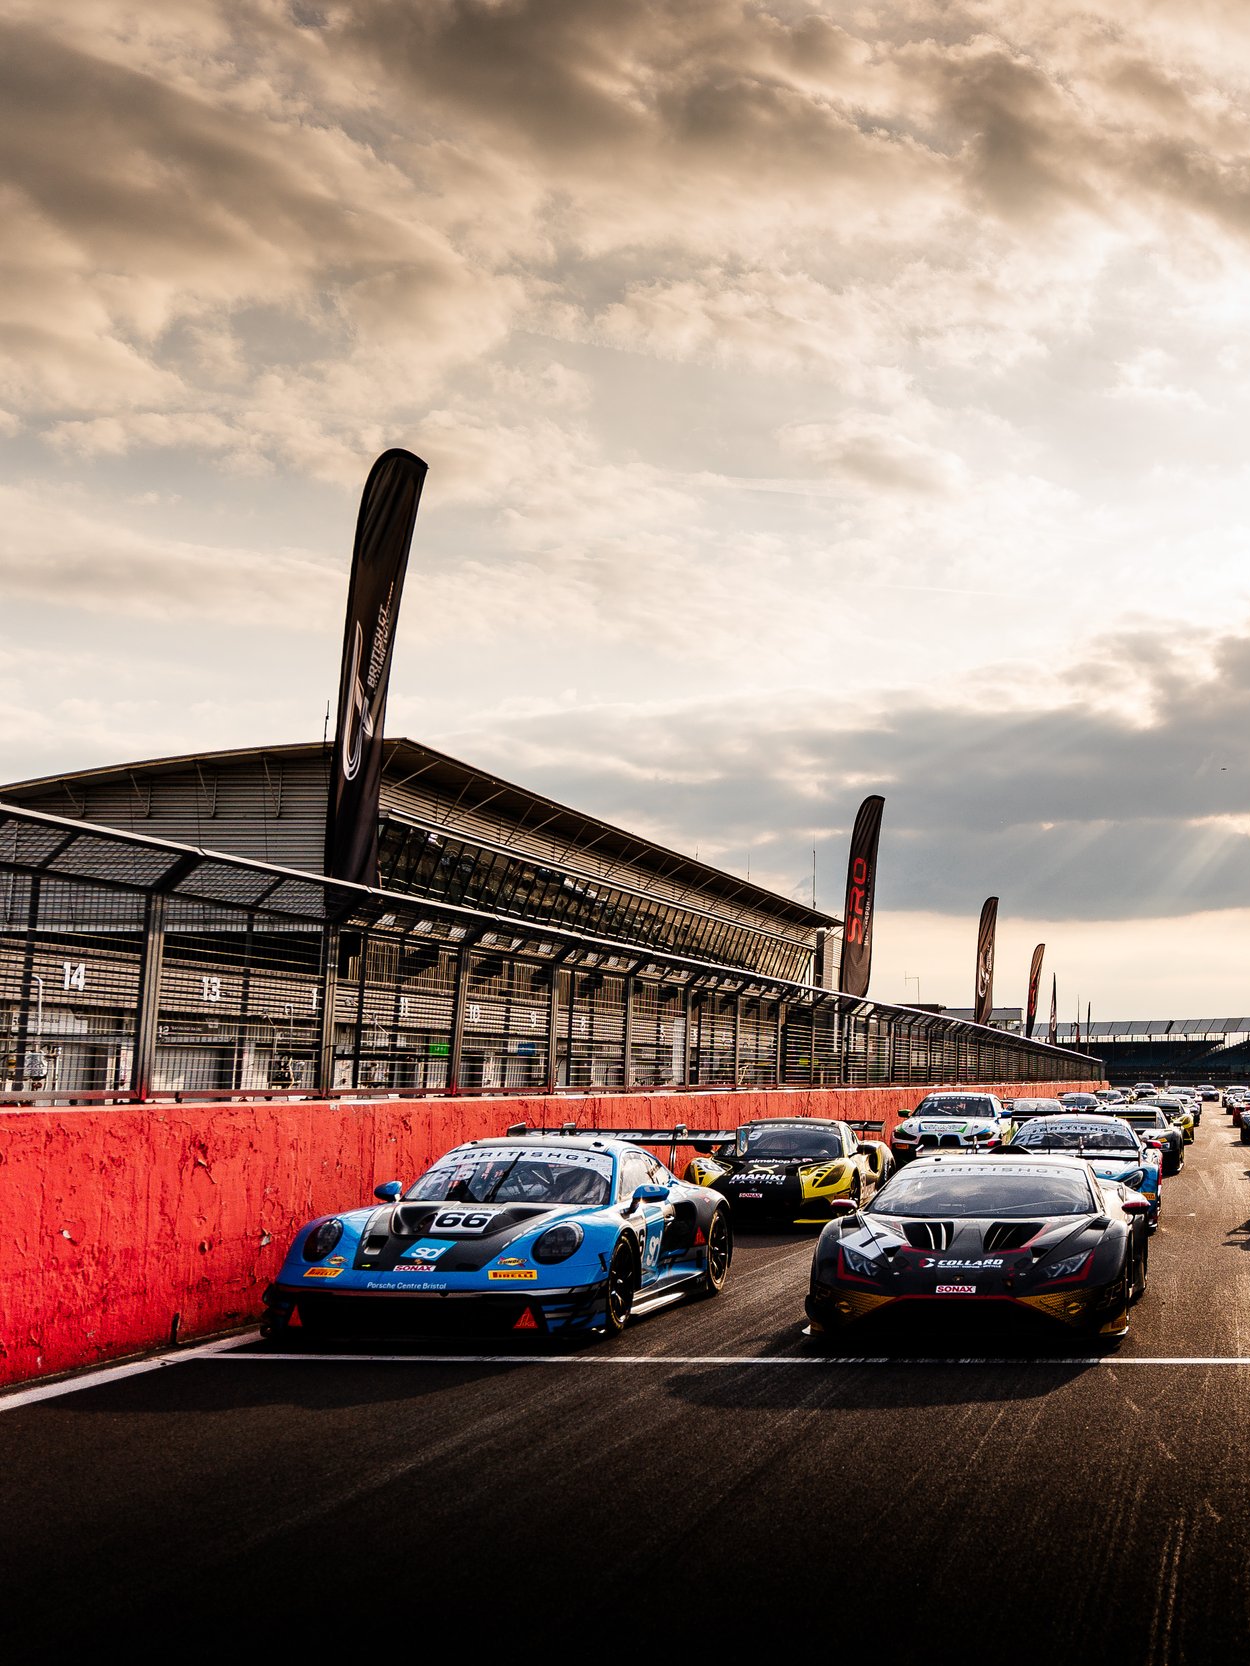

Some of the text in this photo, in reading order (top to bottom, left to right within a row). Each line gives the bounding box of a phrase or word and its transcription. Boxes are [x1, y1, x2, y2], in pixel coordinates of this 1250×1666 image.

[367, 626, 385, 689] BRITISH
[847, 857, 867, 945] SRO
[63, 961, 86, 991] 14
[202, 976, 221, 1002] 13
[400, 997, 409, 1018] 11
[469, 1004, 480, 1023] 10
[922, 1101, 939, 1109] 71
[1032, 1124, 1118, 1134] #BRITISHGT
[1014, 1134, 1045, 1145] 42
[451, 1151, 596, 1162] #BRITISHGT
[435, 1212, 489, 1228] 66
[366, 1281, 447, 1290] Porsche Centre Bristol
